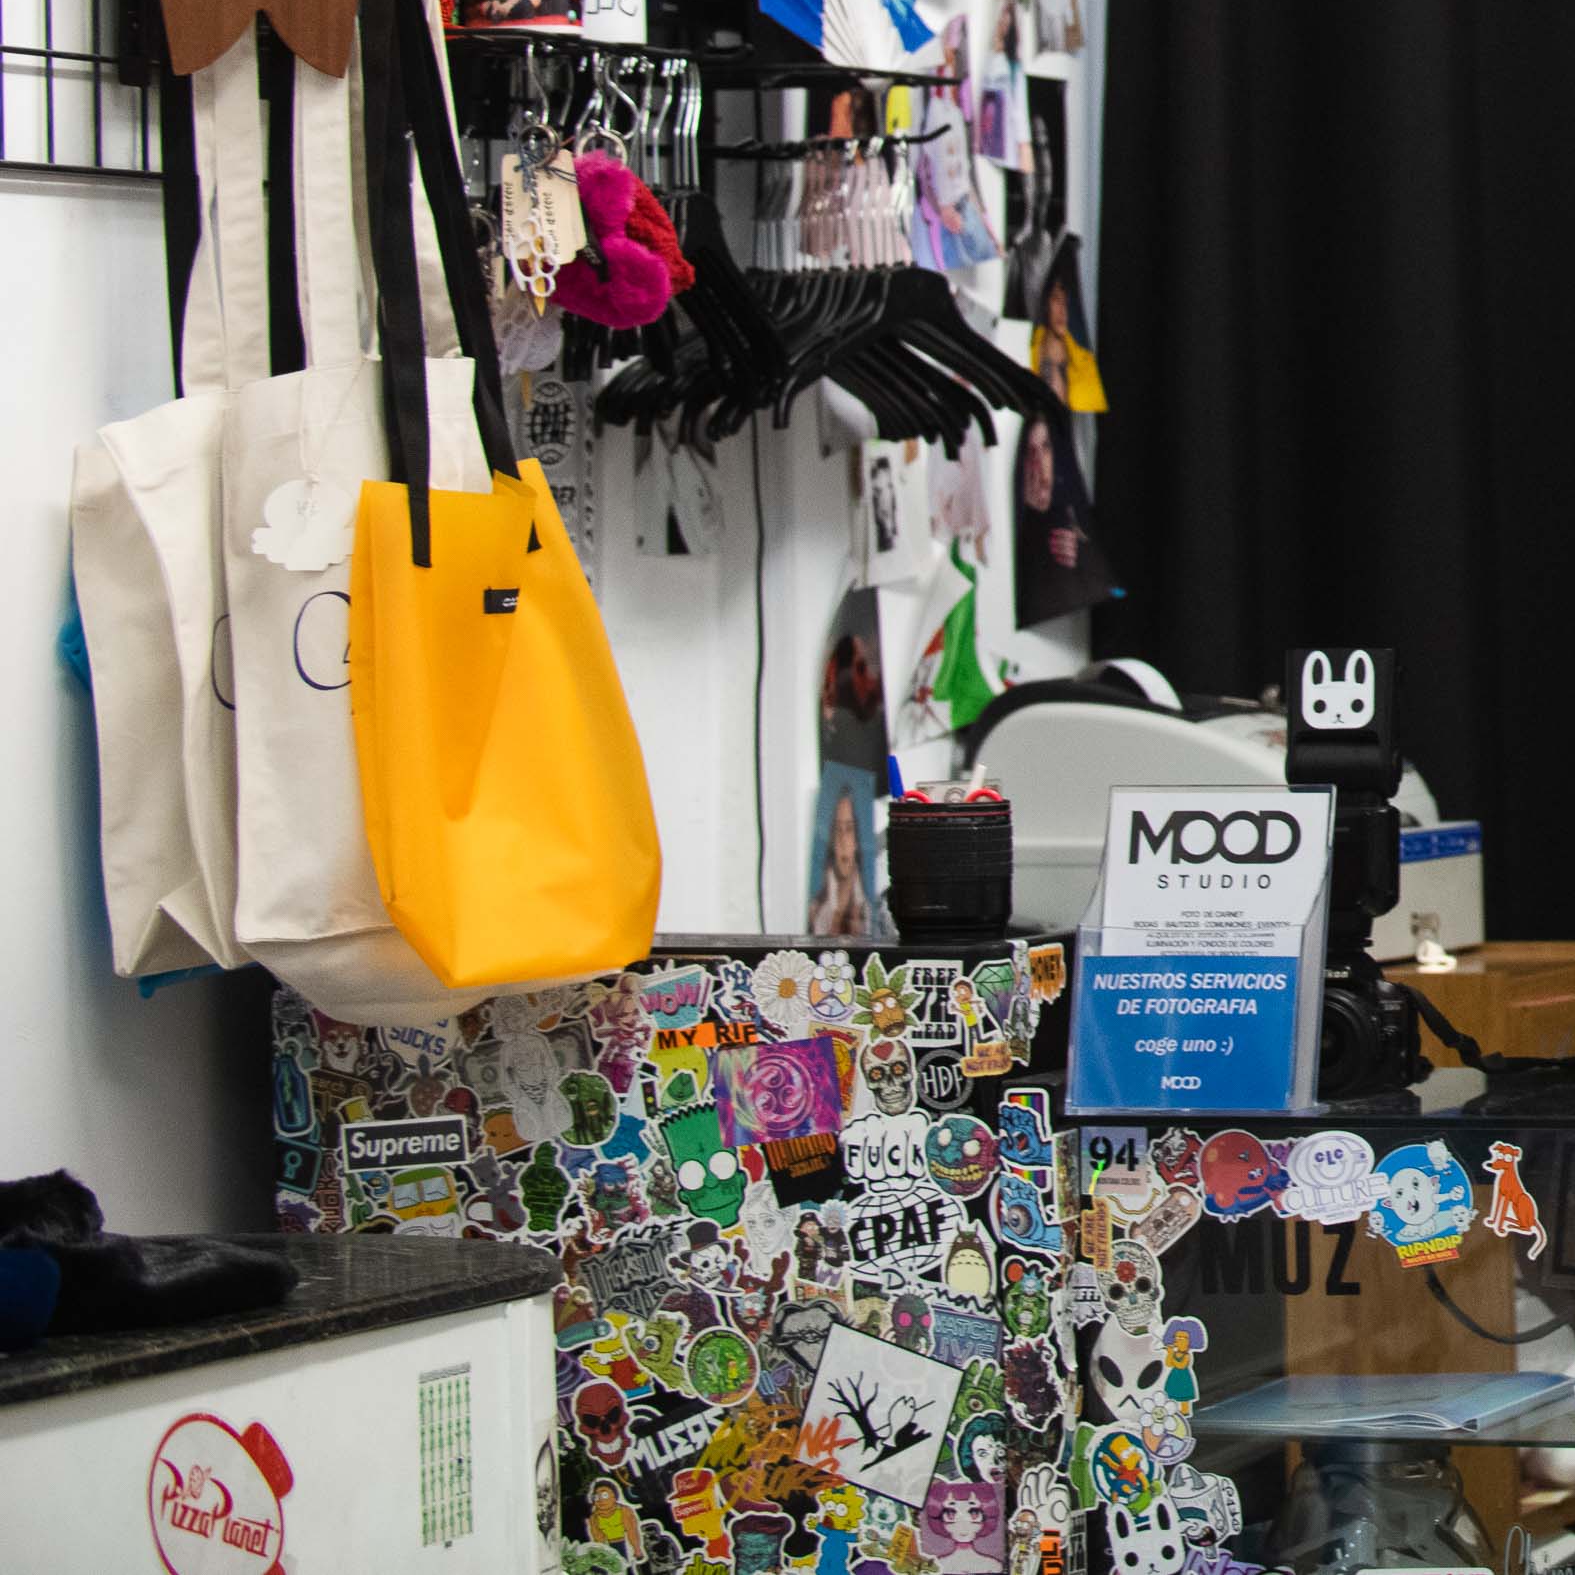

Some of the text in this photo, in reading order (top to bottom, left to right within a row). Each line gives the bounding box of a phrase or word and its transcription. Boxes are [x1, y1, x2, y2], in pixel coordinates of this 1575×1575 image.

[1128, 810, 1301, 864] MOOD
[1157, 874, 1272, 889] STUDIO
[912, 967, 958, 986] FREE
[1093, 974, 1287, 990] NUESTROS SERVICIOS
[639, 976, 711, 1015] WOW!
[1117, 998, 1258, 1014] DE FOTOGRAFIA
[389, 1024, 447, 1057] SUCKS
[656, 1029, 698, 1050] MY
[1135, 1037, 1178, 1056] coge
[1182, 1039, 1217, 1052] uno
[1160, 1076, 1201, 1089] MOOD
[350, 1132, 461, 1164] Supreme
[846, 1144, 925, 1172] FUCK
[1089, 1136, 1139, 1171] 94
[1314, 1149, 1344, 1165] CLC
[1285, 1174, 1388, 1210] CULTURE
[1396, 1235, 1464, 1259] RIPNDIP
[158, 1457, 275, 1557] Pizza Planet
